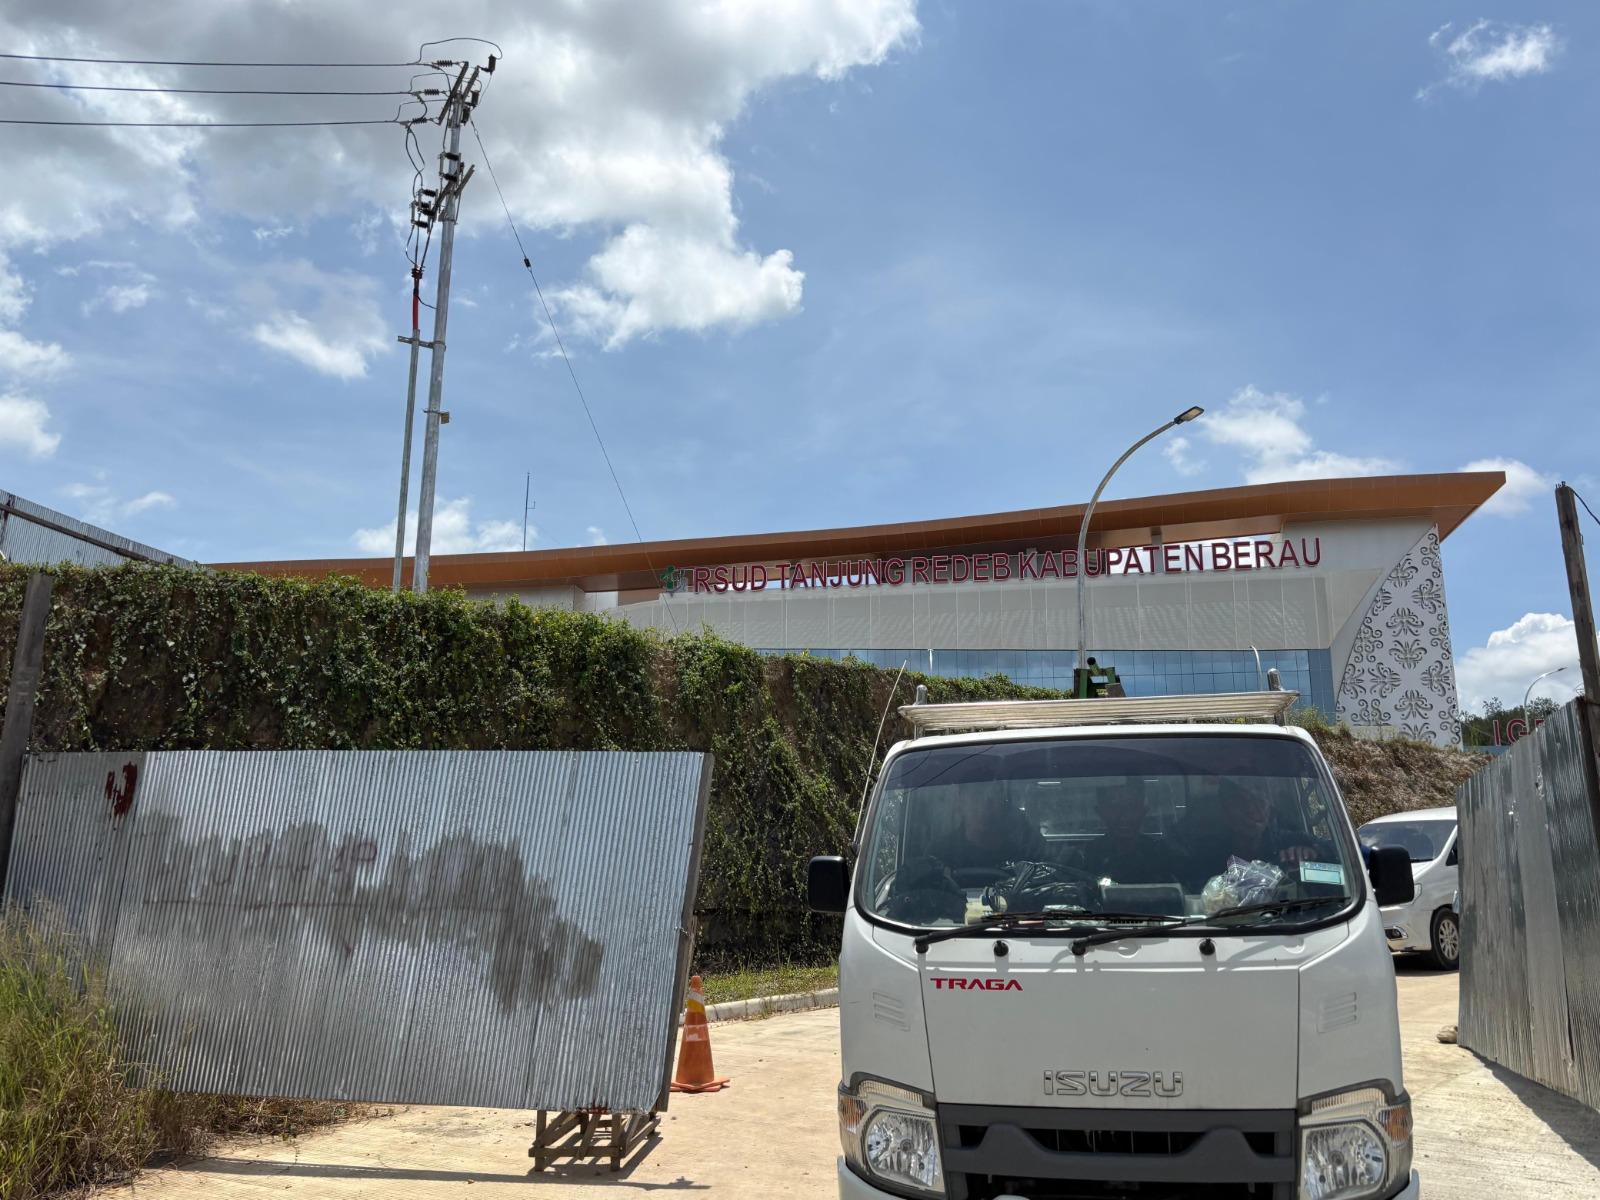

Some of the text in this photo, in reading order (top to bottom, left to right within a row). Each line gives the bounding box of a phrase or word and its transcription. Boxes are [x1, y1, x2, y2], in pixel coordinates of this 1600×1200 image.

[693, 537, 1321, 594] RSUD TANJUNG REDEB KABUPATEN BERAU
[930, 977, 1023, 991] TRAGA
[1043, 1070, 1183, 1097] ISUZU
